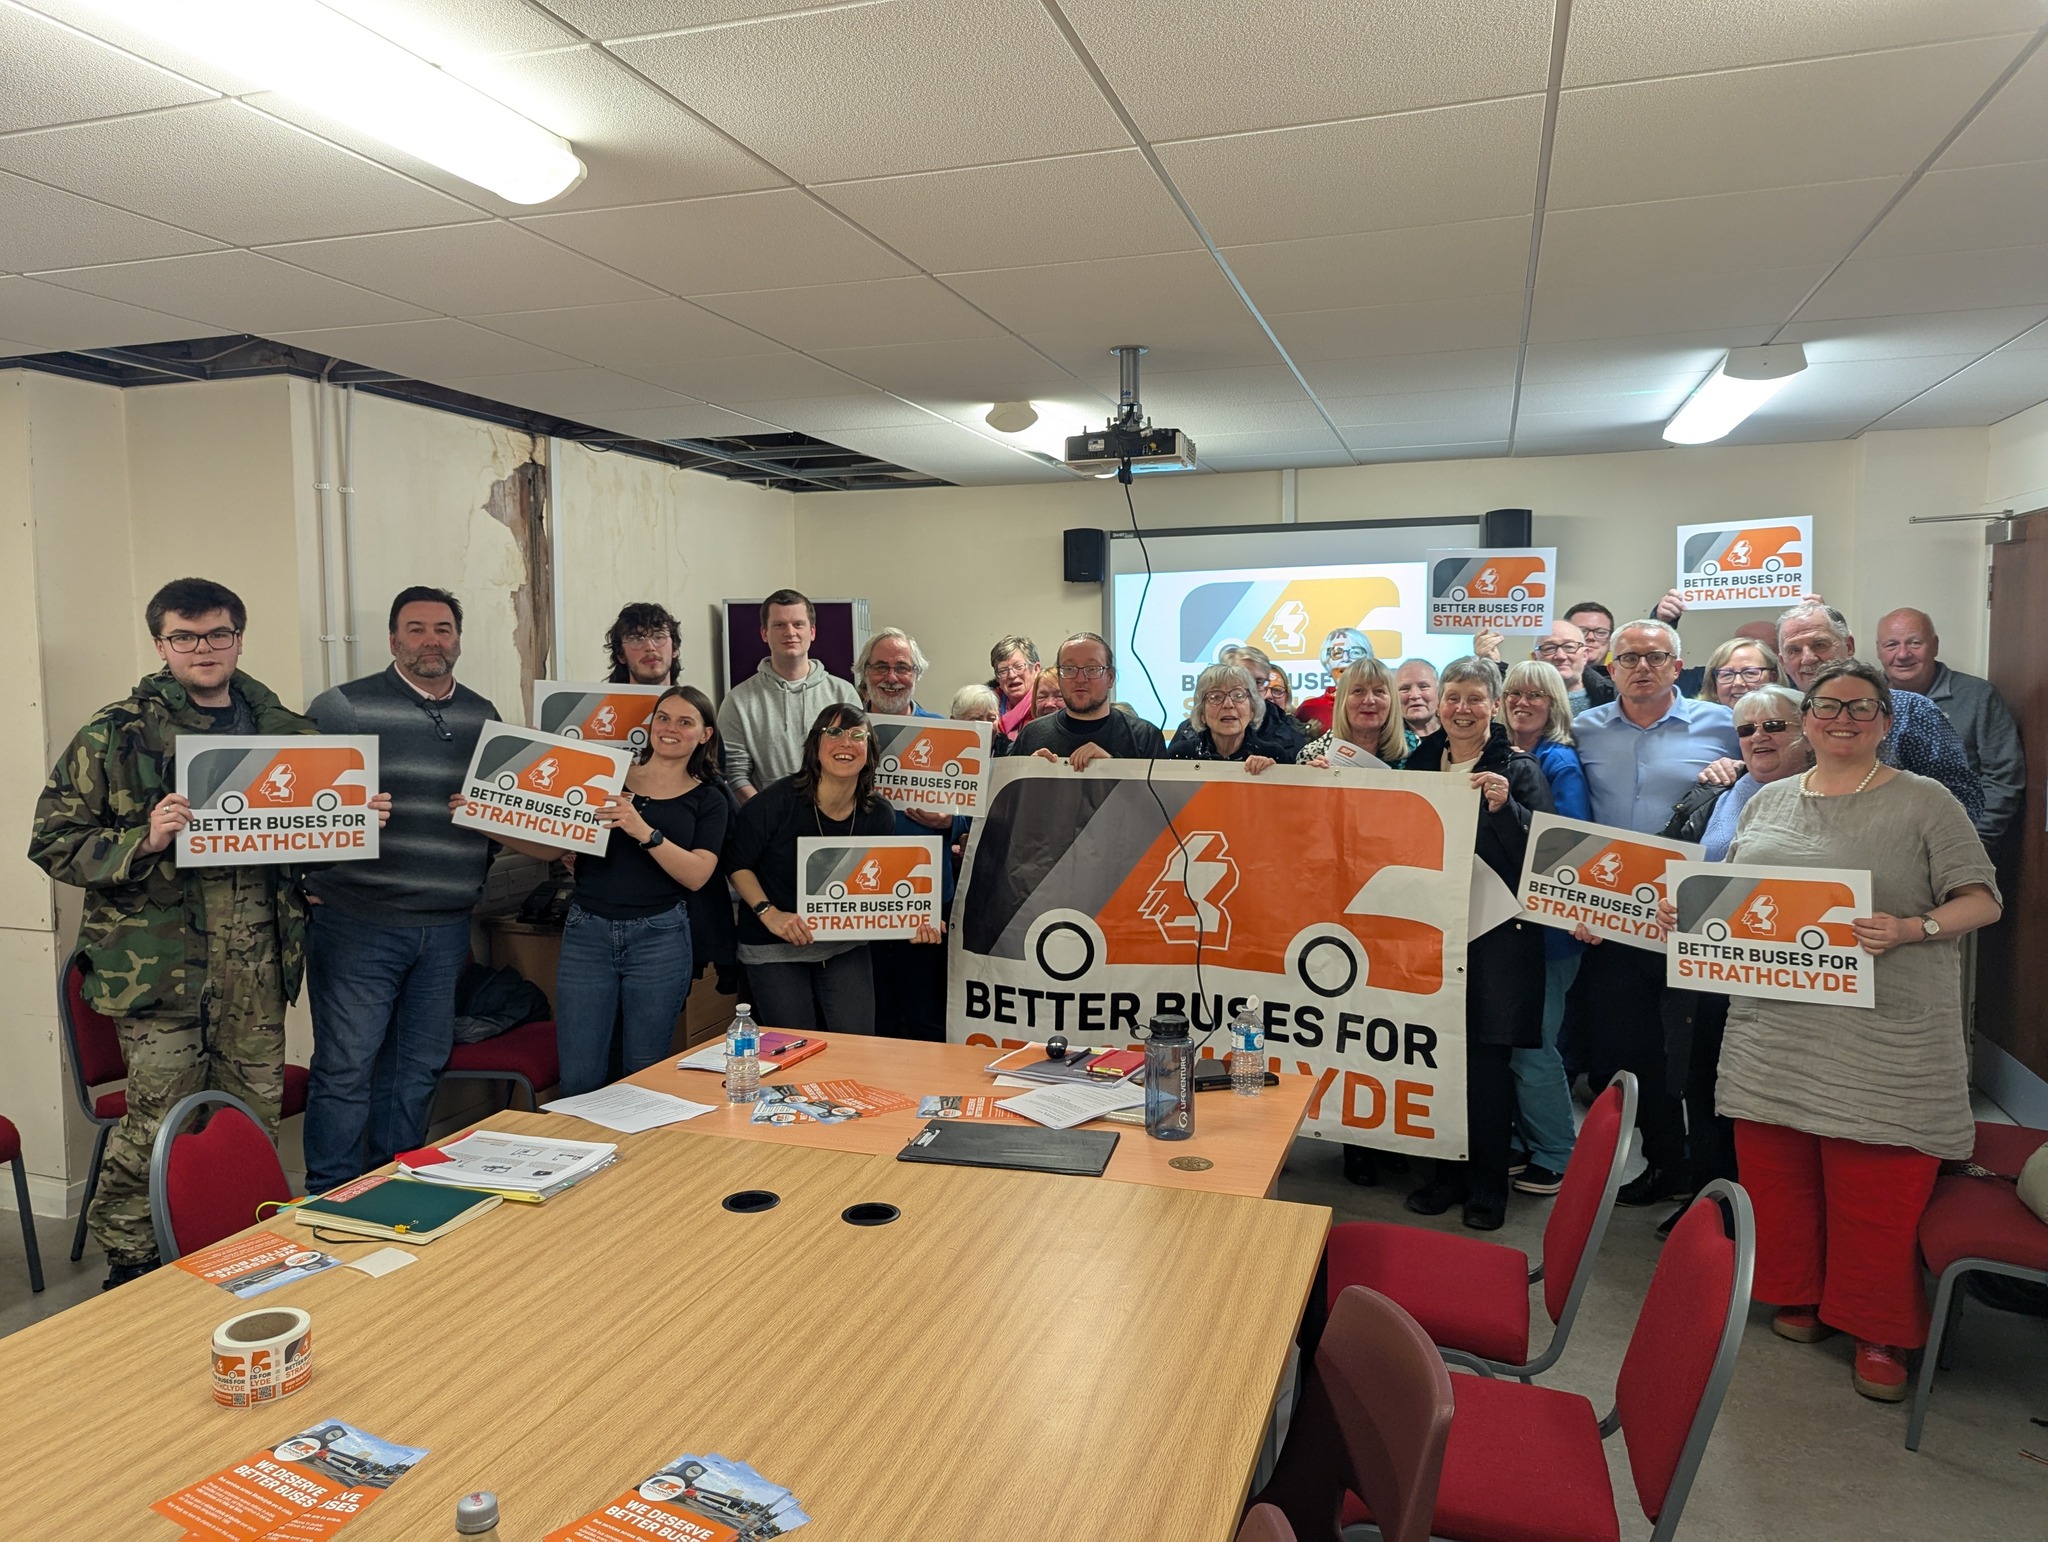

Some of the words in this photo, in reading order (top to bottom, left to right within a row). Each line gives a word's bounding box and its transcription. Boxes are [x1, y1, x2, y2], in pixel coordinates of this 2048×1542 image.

[1684, 578, 1729, 588] BETTER
[1732, 575, 1773, 585] BUSES
[1776, 573, 1802, 583] FOR
[1684, 585, 1801, 602] STRATHCLYDE
[1433, 604, 1476, 612] BETTER
[1478, 604, 1518, 612] BUSES
[1521, 604, 1544, 612] FOR
[1433, 615, 1543, 627] STRATHCLYDE
[874, 774, 908, 786] ETTER
[911, 776, 951, 789] BUSES
[954, 780, 978, 791] FOR
[470, 786, 524, 808] BETTER
[525, 799, 572, 819] BUSES
[874, 786, 976, 806] TRATHCLYDE
[189, 817, 261, 832] BETTER
[267, 814, 328, 830] BUSES
[332, 814, 366, 828] FOR
[465, 801, 598, 843] STRATHCLYDE
[189, 830, 365, 854] STRATHCLYDE
[806, 902, 857, 913] BETTER
[860, 901, 903, 912] BUSES
[907, 900, 931, 911] FOR
[1528, 881, 1587, 903] BETTER
[1590, 895, 1642, 917] BUSES
[806, 914, 931, 931] STRATHCLYDE
[1678, 942, 1744, 961] BETTER
[1749, 948, 1813, 966] BUSES
[1819, 954, 1858, 970] FOR
[1678, 959, 1858, 993] STRATHCLYDE
[964, 980, 1142, 1031] BETTER
[1336, 1012, 1438, 1069] FOR
[233, 1465, 280, 1490] BETTER
[274, 1484, 318, 1508] BUSES
[255, 1460, 279, 1473] WE
[271, 1467, 328, 1497] DESERVE
[604, 1506, 660, 1532] BETTER
[657, 1526, 700, 1542] BUS
[624, 1500, 650, 1514] WE
[646, 1508, 714, 1541] DESERVE
